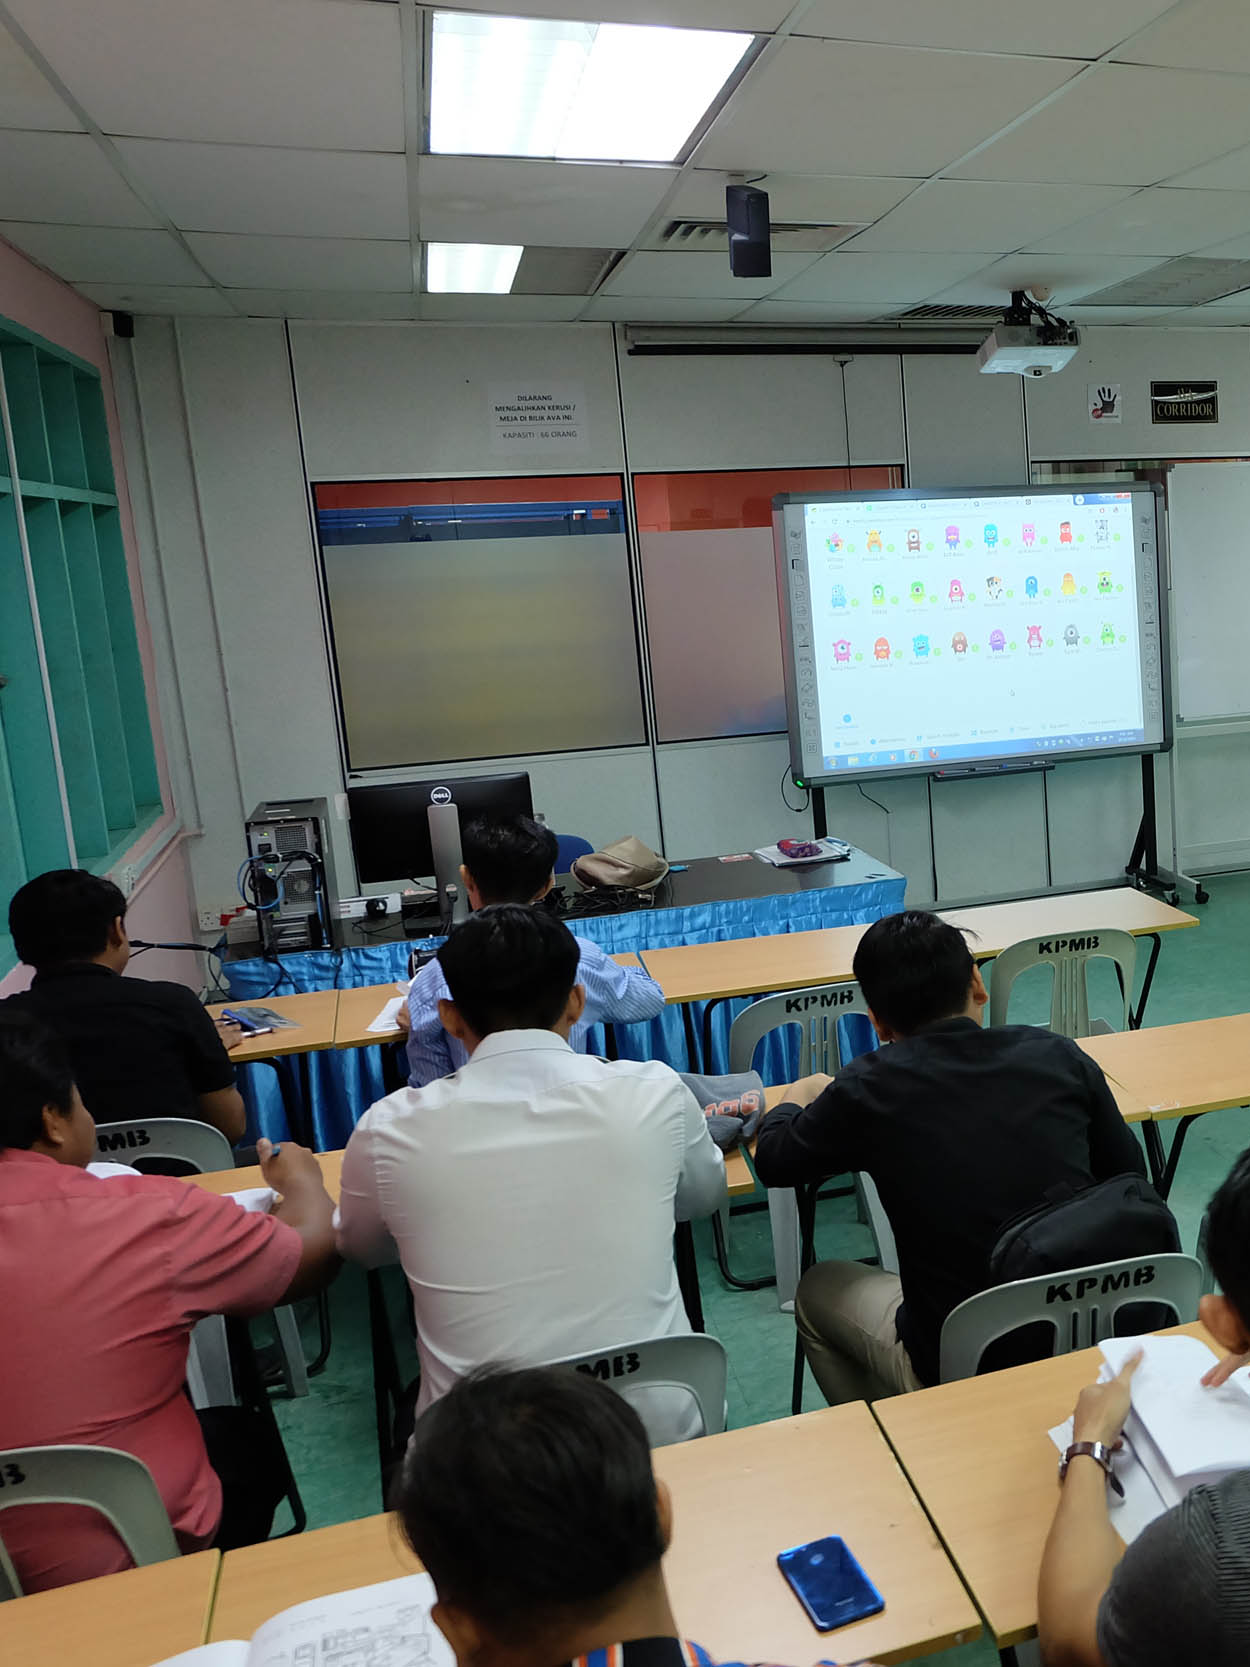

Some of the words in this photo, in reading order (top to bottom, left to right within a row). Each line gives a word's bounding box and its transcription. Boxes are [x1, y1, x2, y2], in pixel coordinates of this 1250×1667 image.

[1157, 403, 1213, 416] CORRIDOR
[502, 431, 535, 439] KAPASITI
[1038, 936, 1100, 954] KPMB
[785, 990, 854, 1013] KPMB
[97, 1129, 151, 1152] MB
[1046, 1265, 1156, 1304] KPMB
[576, 1352, 640, 1380] MB
